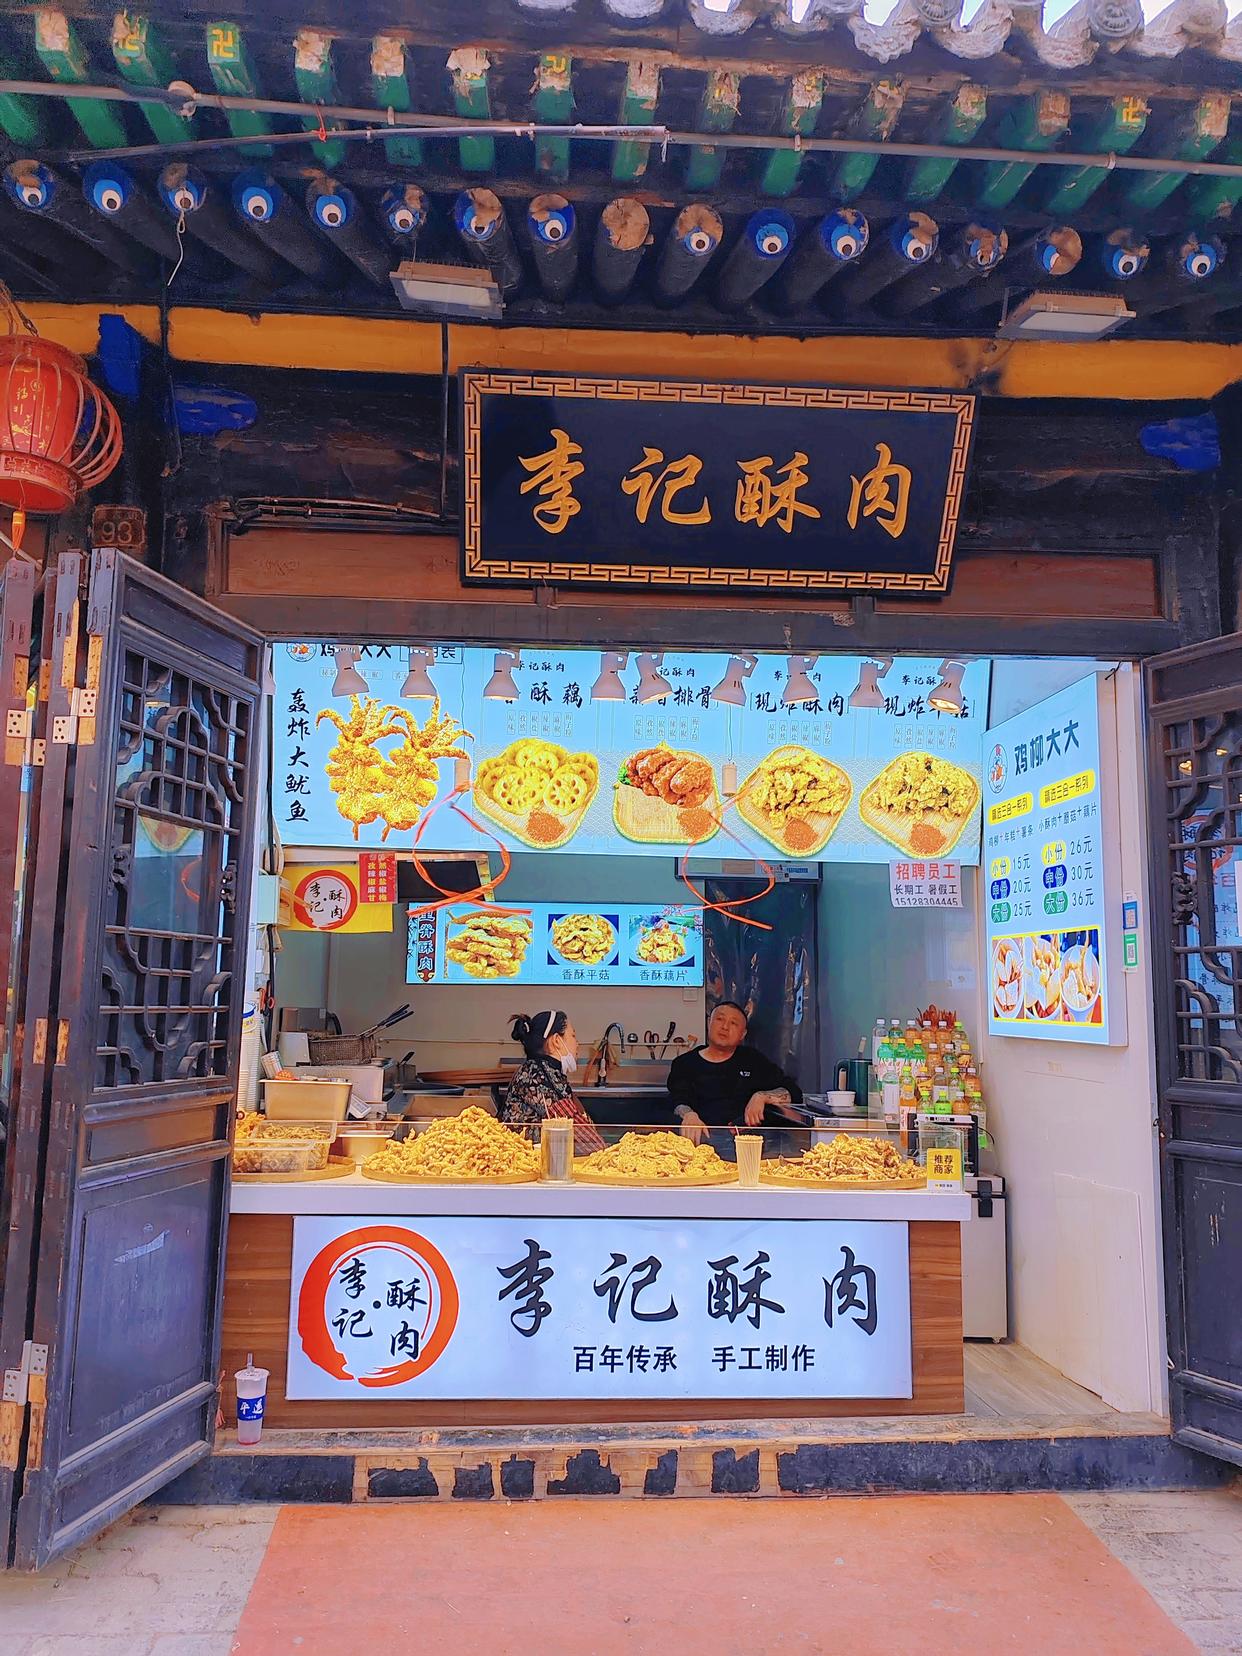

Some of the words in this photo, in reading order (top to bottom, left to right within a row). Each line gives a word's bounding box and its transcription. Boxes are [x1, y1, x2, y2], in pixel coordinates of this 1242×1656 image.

[517, 428, 913, 539] 李记酥肉
[102, 521, 132, 543] 93
[659, 667, 695, 678] 记酥肉
[902, 674, 938, 686] 李记酥
[505, 681, 583, 709] 酥藕
[1014, 719, 1079, 776] 鸡柳大大
[1070, 835, 1093, 856] 26元
[895, 862, 956, 880] 招聘员工
[1013, 853, 1031, 870] 15元
[1071, 861, 1094, 881] 30元
[894, 884, 924, 895] 长期工
[928, 884, 958, 895] 暑假工
[1013, 876, 1032, 894] 20元
[309, 882, 324, 913] 李记
[328, 888, 346, 919] 酥肉
[895, 897, 959, 906] 15128304445
[1071, 888, 1095, 907] 36元
[1013, 900, 1032, 917] 25元
[561, 968, 610, 981] 香酥平菇
[639, 969, 686, 982] 香酥藕片
[934, 1154, 954, 1165] 推荐
[933, 1164, 954, 1175] 商家
[496, 1238, 879, 1337] 李记酥肉
[331, 1257, 374, 1339] 李记
[386, 1278, 428, 1361] 酥肉
[573, 1344, 678, 1374] 百年传承
[711, 1344, 816, 1373] 手工制作
